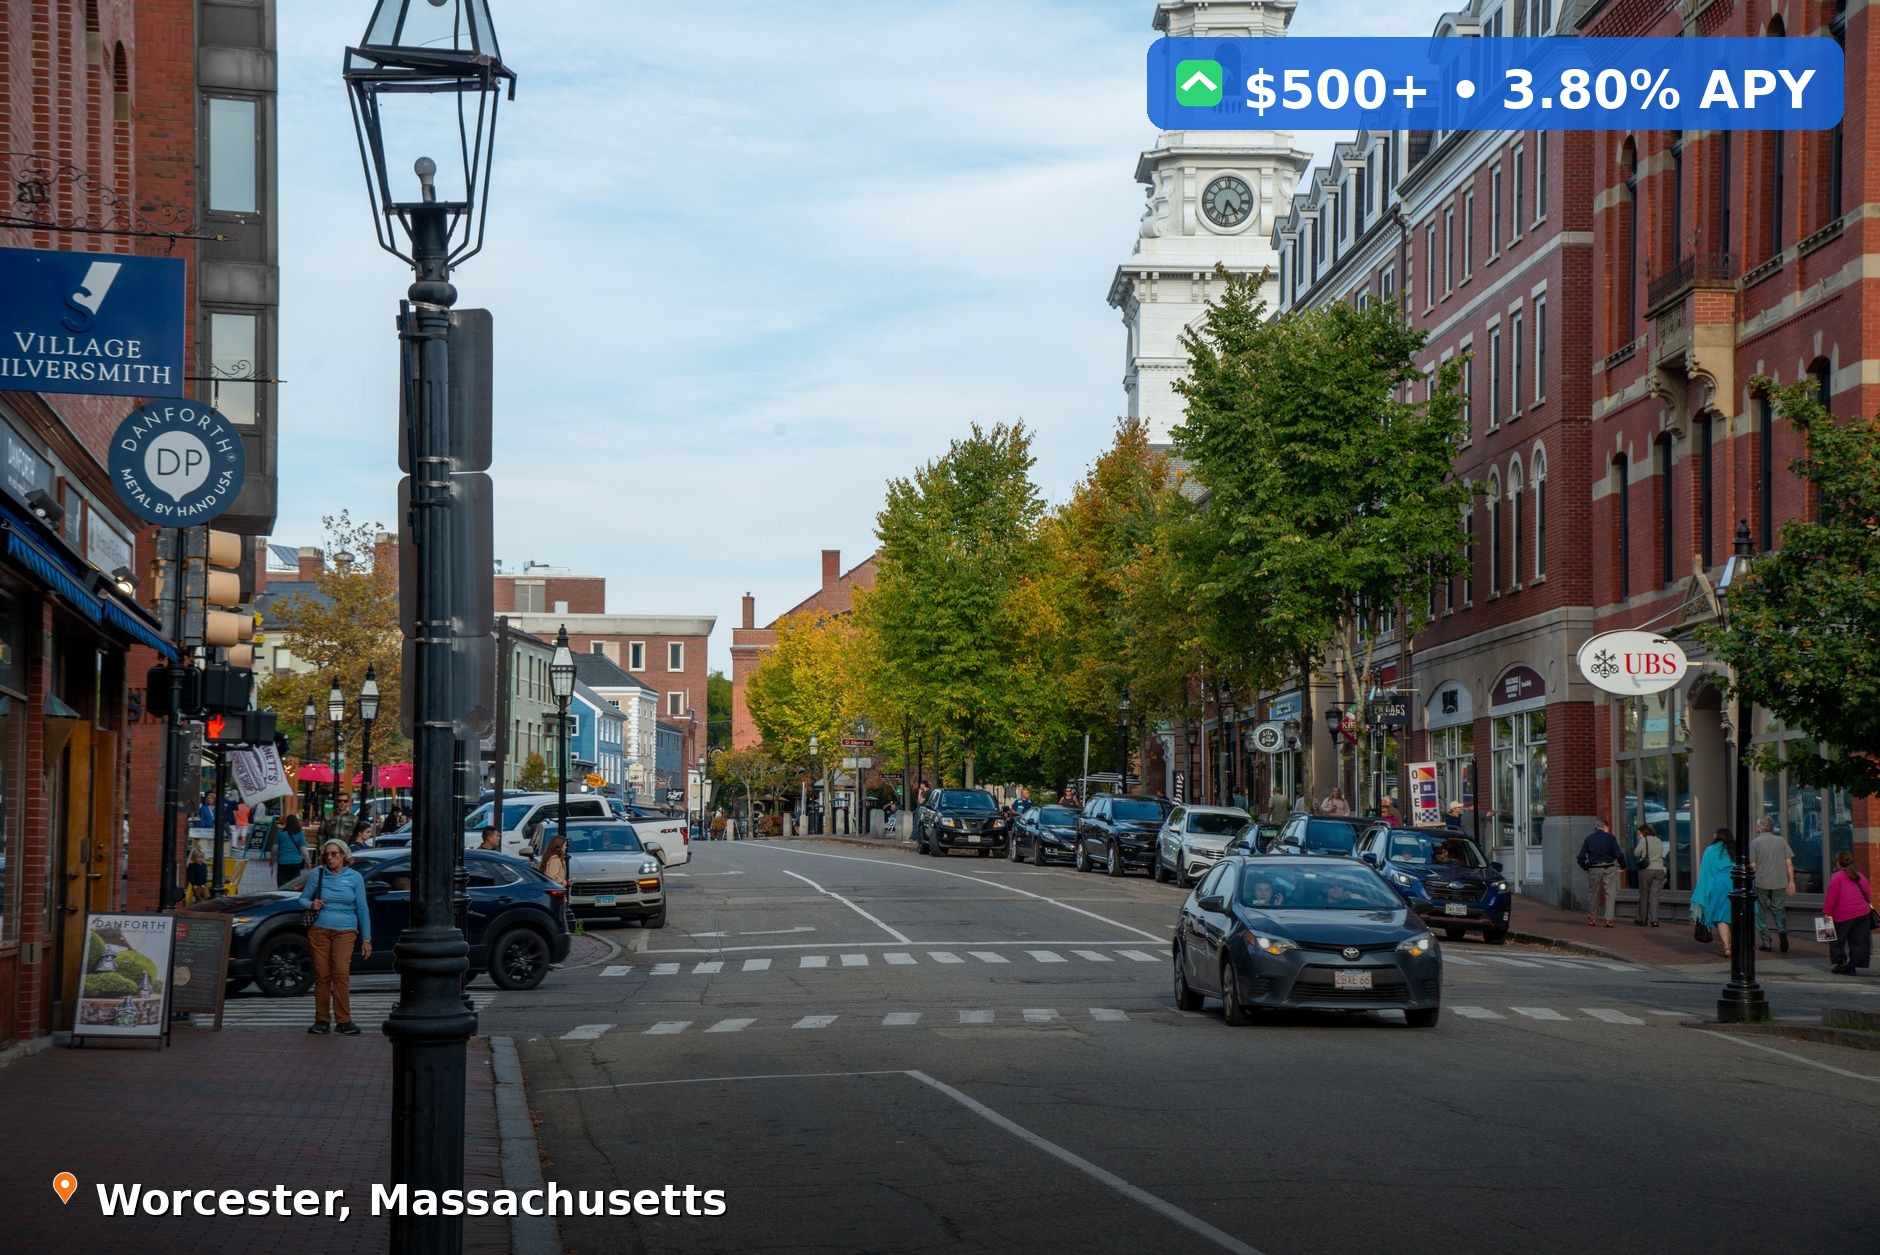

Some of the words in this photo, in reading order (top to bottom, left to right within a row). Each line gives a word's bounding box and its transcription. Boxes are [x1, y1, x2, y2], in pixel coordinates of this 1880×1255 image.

[14, 332, 142, 359] VILLAGE
[0, 357, 171, 385] ILVERSMITH
[121, 407, 233, 452] DANFORTH
[157, 448, 203, 476] DP
[121, 468, 152, 508] METAL
[155, 502, 174, 516] BY
[177, 494, 217, 517] HAND
[214, 469, 234, 494] USA
[1624, 652, 1677, 675] UBS
[1411, 769, 1422, 822] OPEN
[95, 919, 166, 930] DANFORTH
